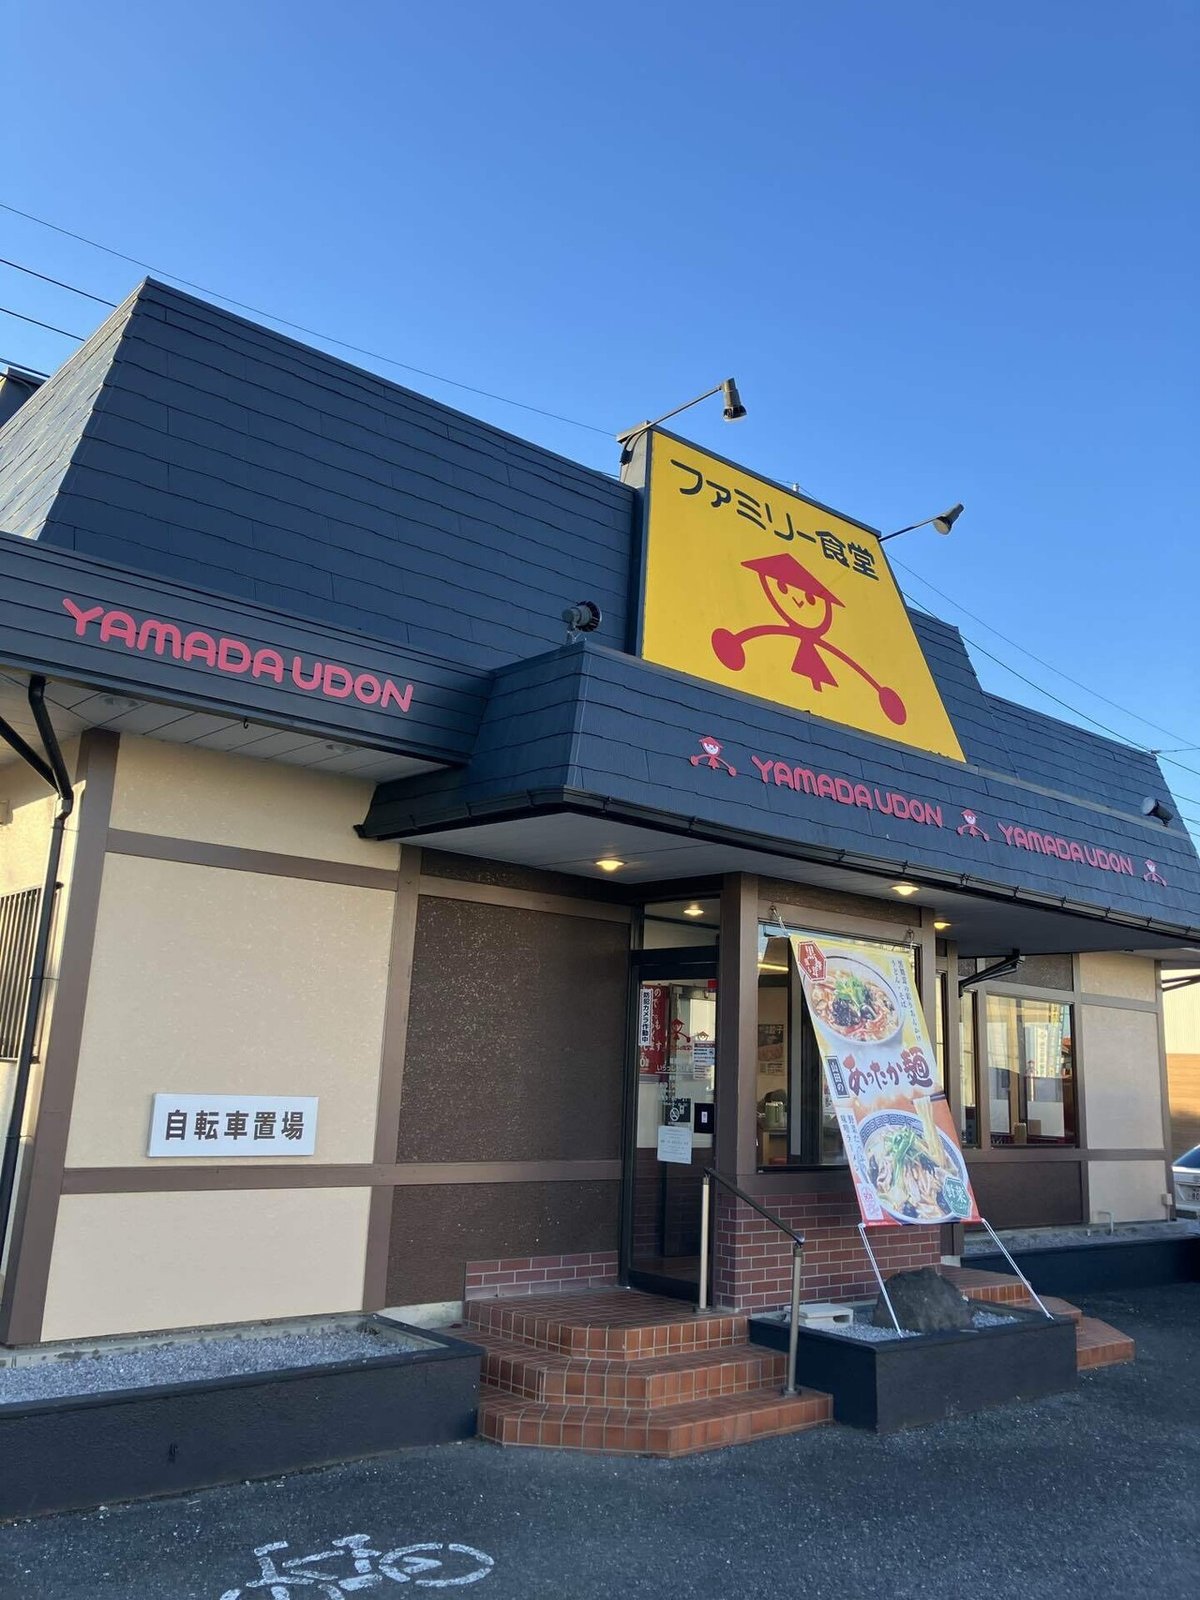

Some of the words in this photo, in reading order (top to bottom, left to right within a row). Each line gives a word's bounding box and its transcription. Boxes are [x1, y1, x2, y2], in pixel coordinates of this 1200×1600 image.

[670, 458, 880, 581] ファミリー食堂
[62, 597, 285, 685] YAMADA
[292, 655, 414, 714] UDON
[751, 755, 873, 810] YAMADA
[873, 788, 943, 828] UDON
[997, 822, 1085, 864] YAMADA
[1083, 845, 1134, 876] UDON
[641, 991, 651, 1043] 防犯カメラ作動中
[829, 1060, 845, 1092] 山田の
[842, 1046, 933, 1097] あったか麺
[165, 1108, 306, 1141] 自転車置場
